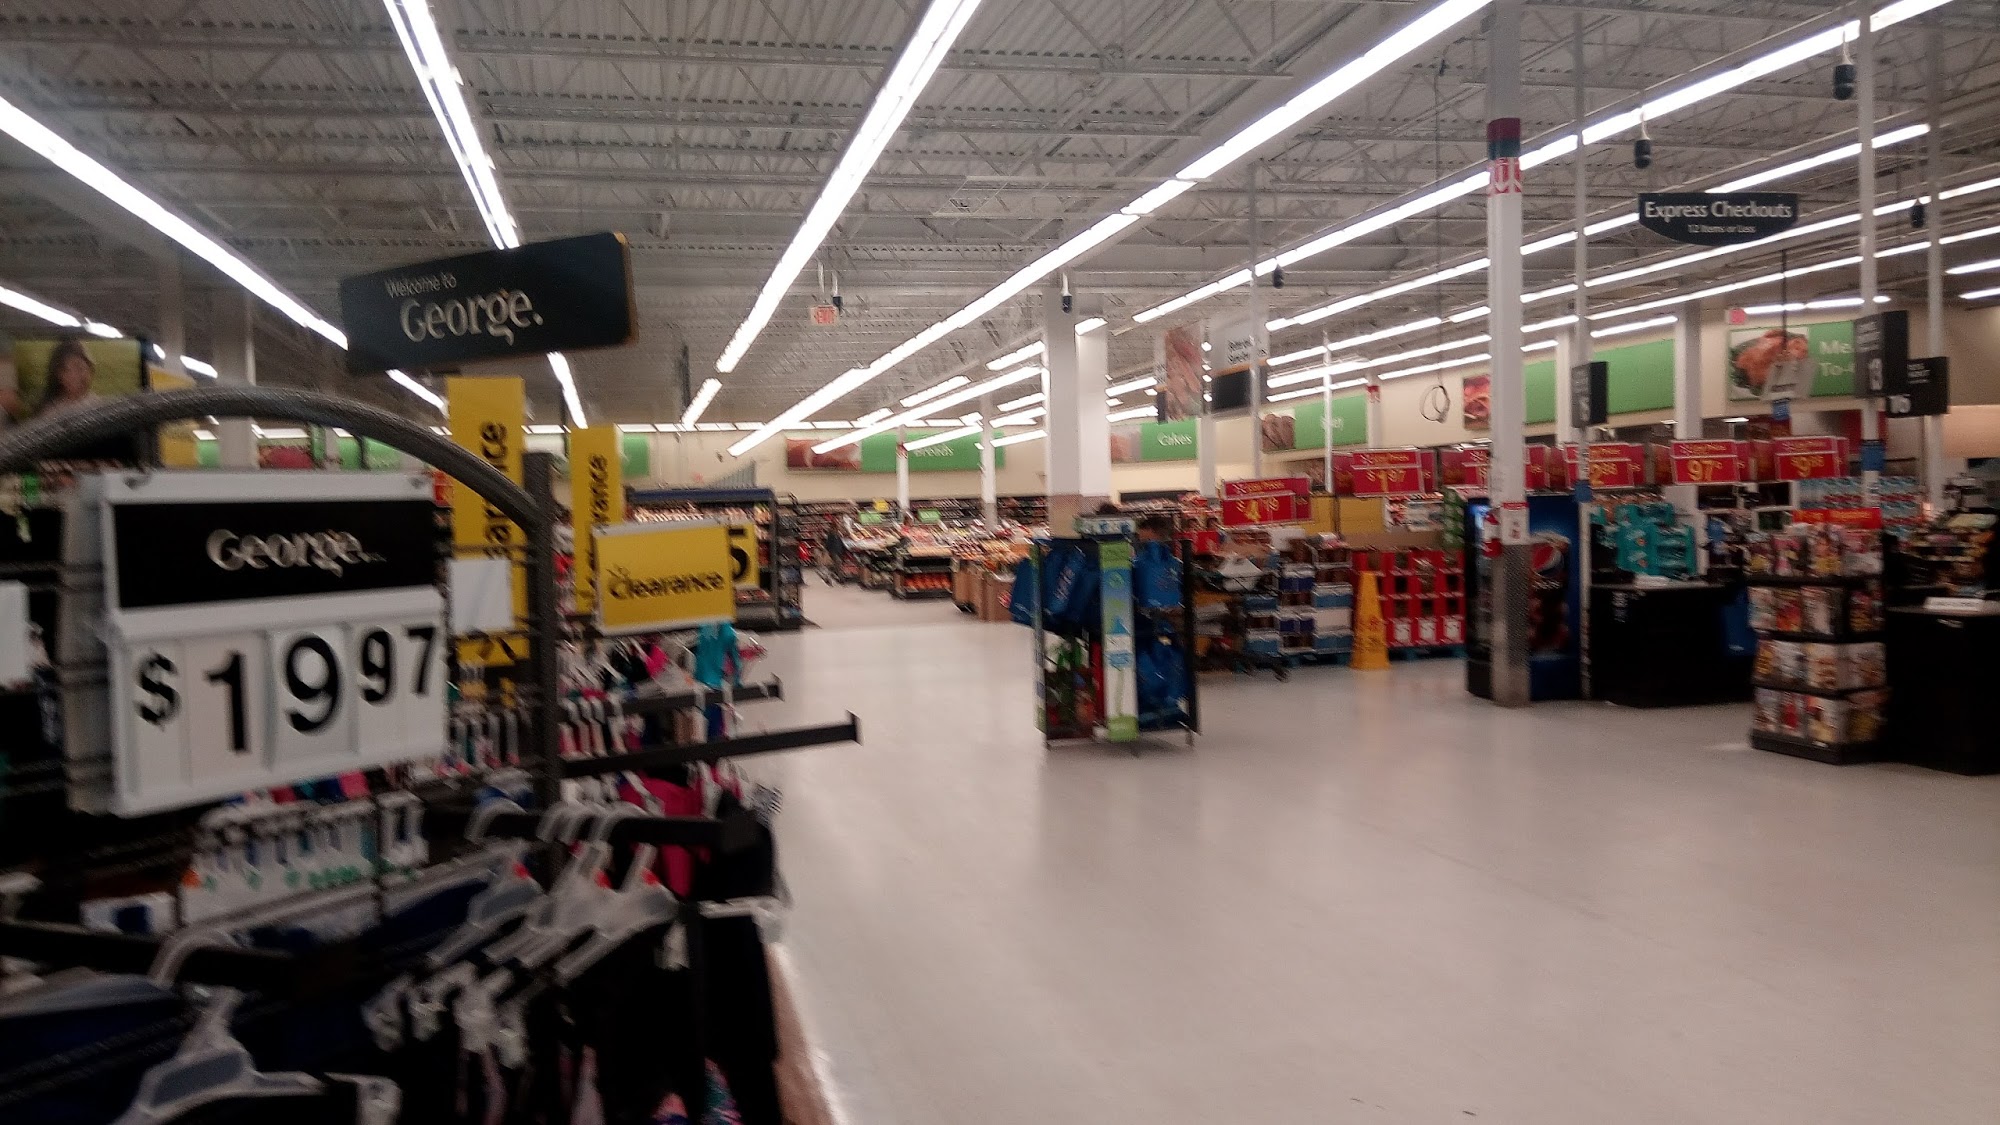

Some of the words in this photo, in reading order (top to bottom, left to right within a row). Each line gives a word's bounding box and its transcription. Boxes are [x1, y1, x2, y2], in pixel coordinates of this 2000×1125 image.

[1645, 201, 1707, 223] Express
[1711, 201, 1793, 218] Checkouts
[385, 274, 441, 299] Welcome
[441, 271, 457, 289] to
[606, 563, 724, 599] Clearance
